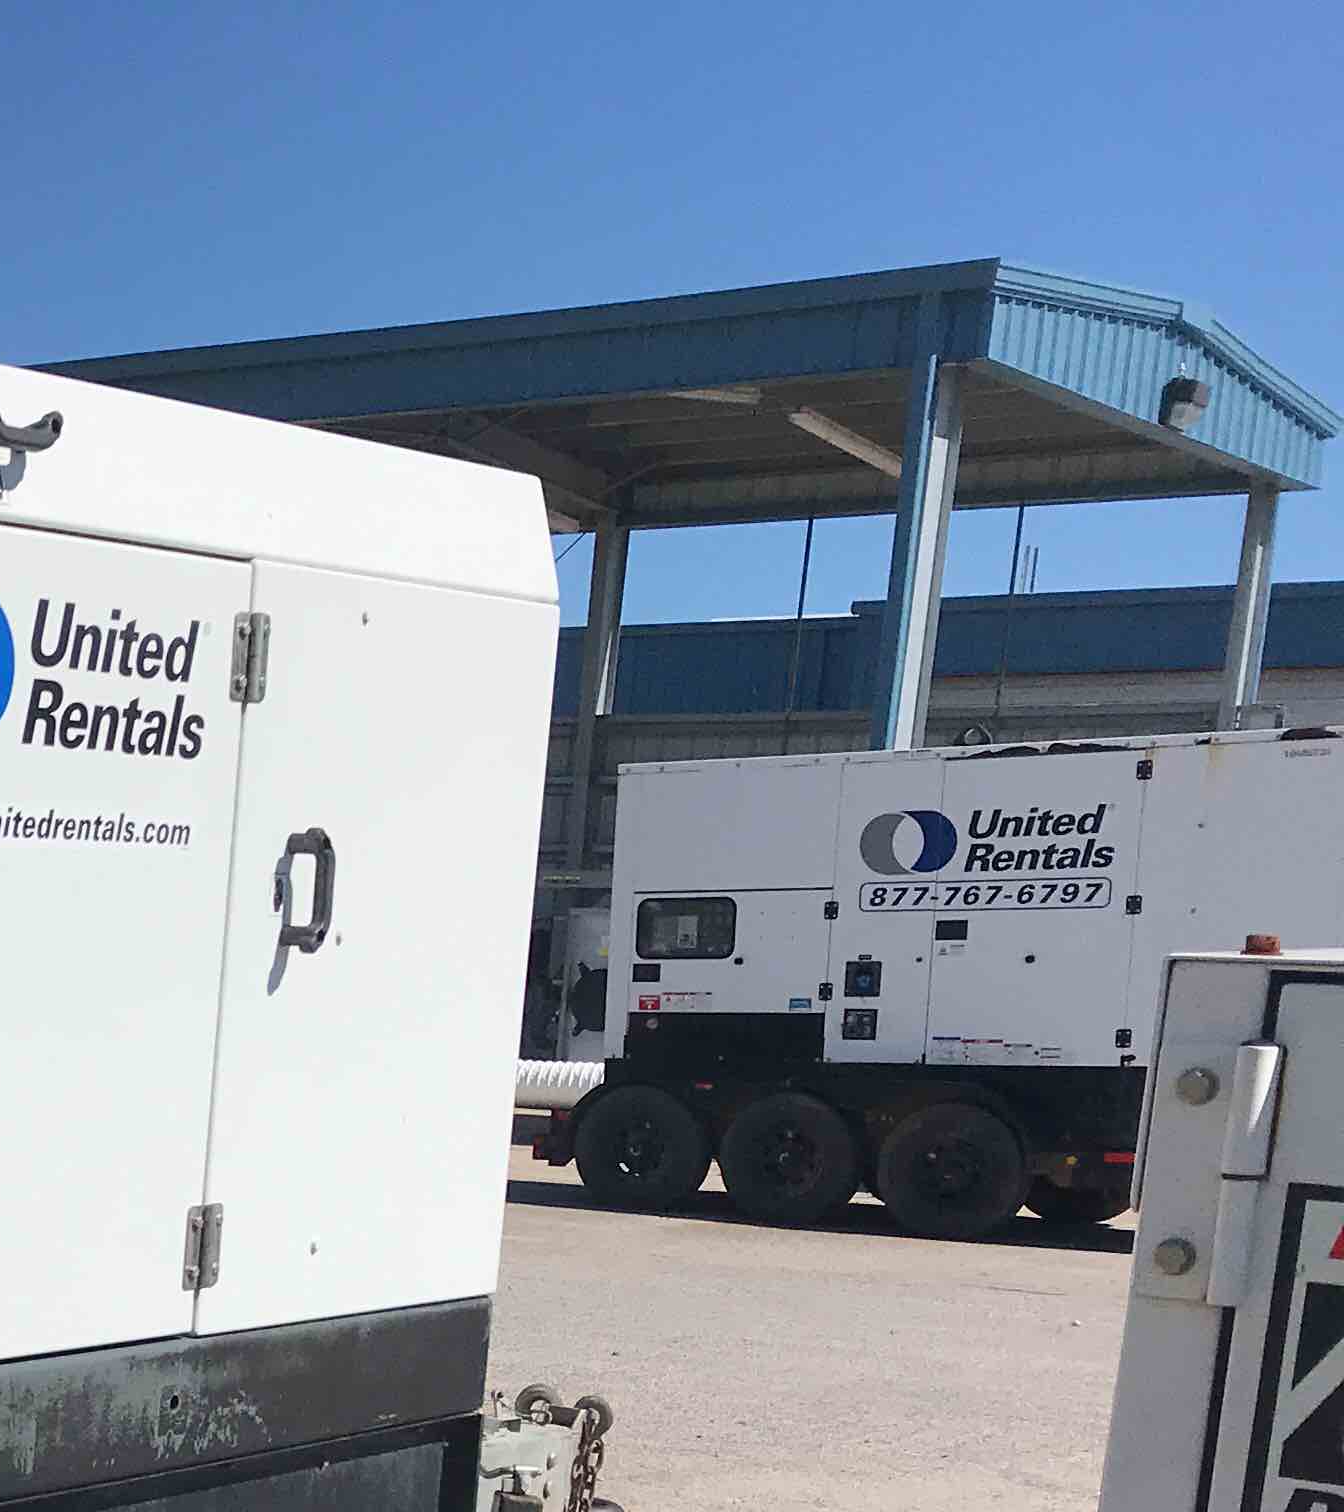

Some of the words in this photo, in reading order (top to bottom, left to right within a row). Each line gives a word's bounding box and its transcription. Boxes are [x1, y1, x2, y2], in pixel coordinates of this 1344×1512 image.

[30, 598, 201, 682] United
[21, 678, 205, 760] Rentals
[967, 803, 1107, 839] United
[964, 839, 1115, 873] Rentals
[868, 882, 1104, 907] 877-767-6797
